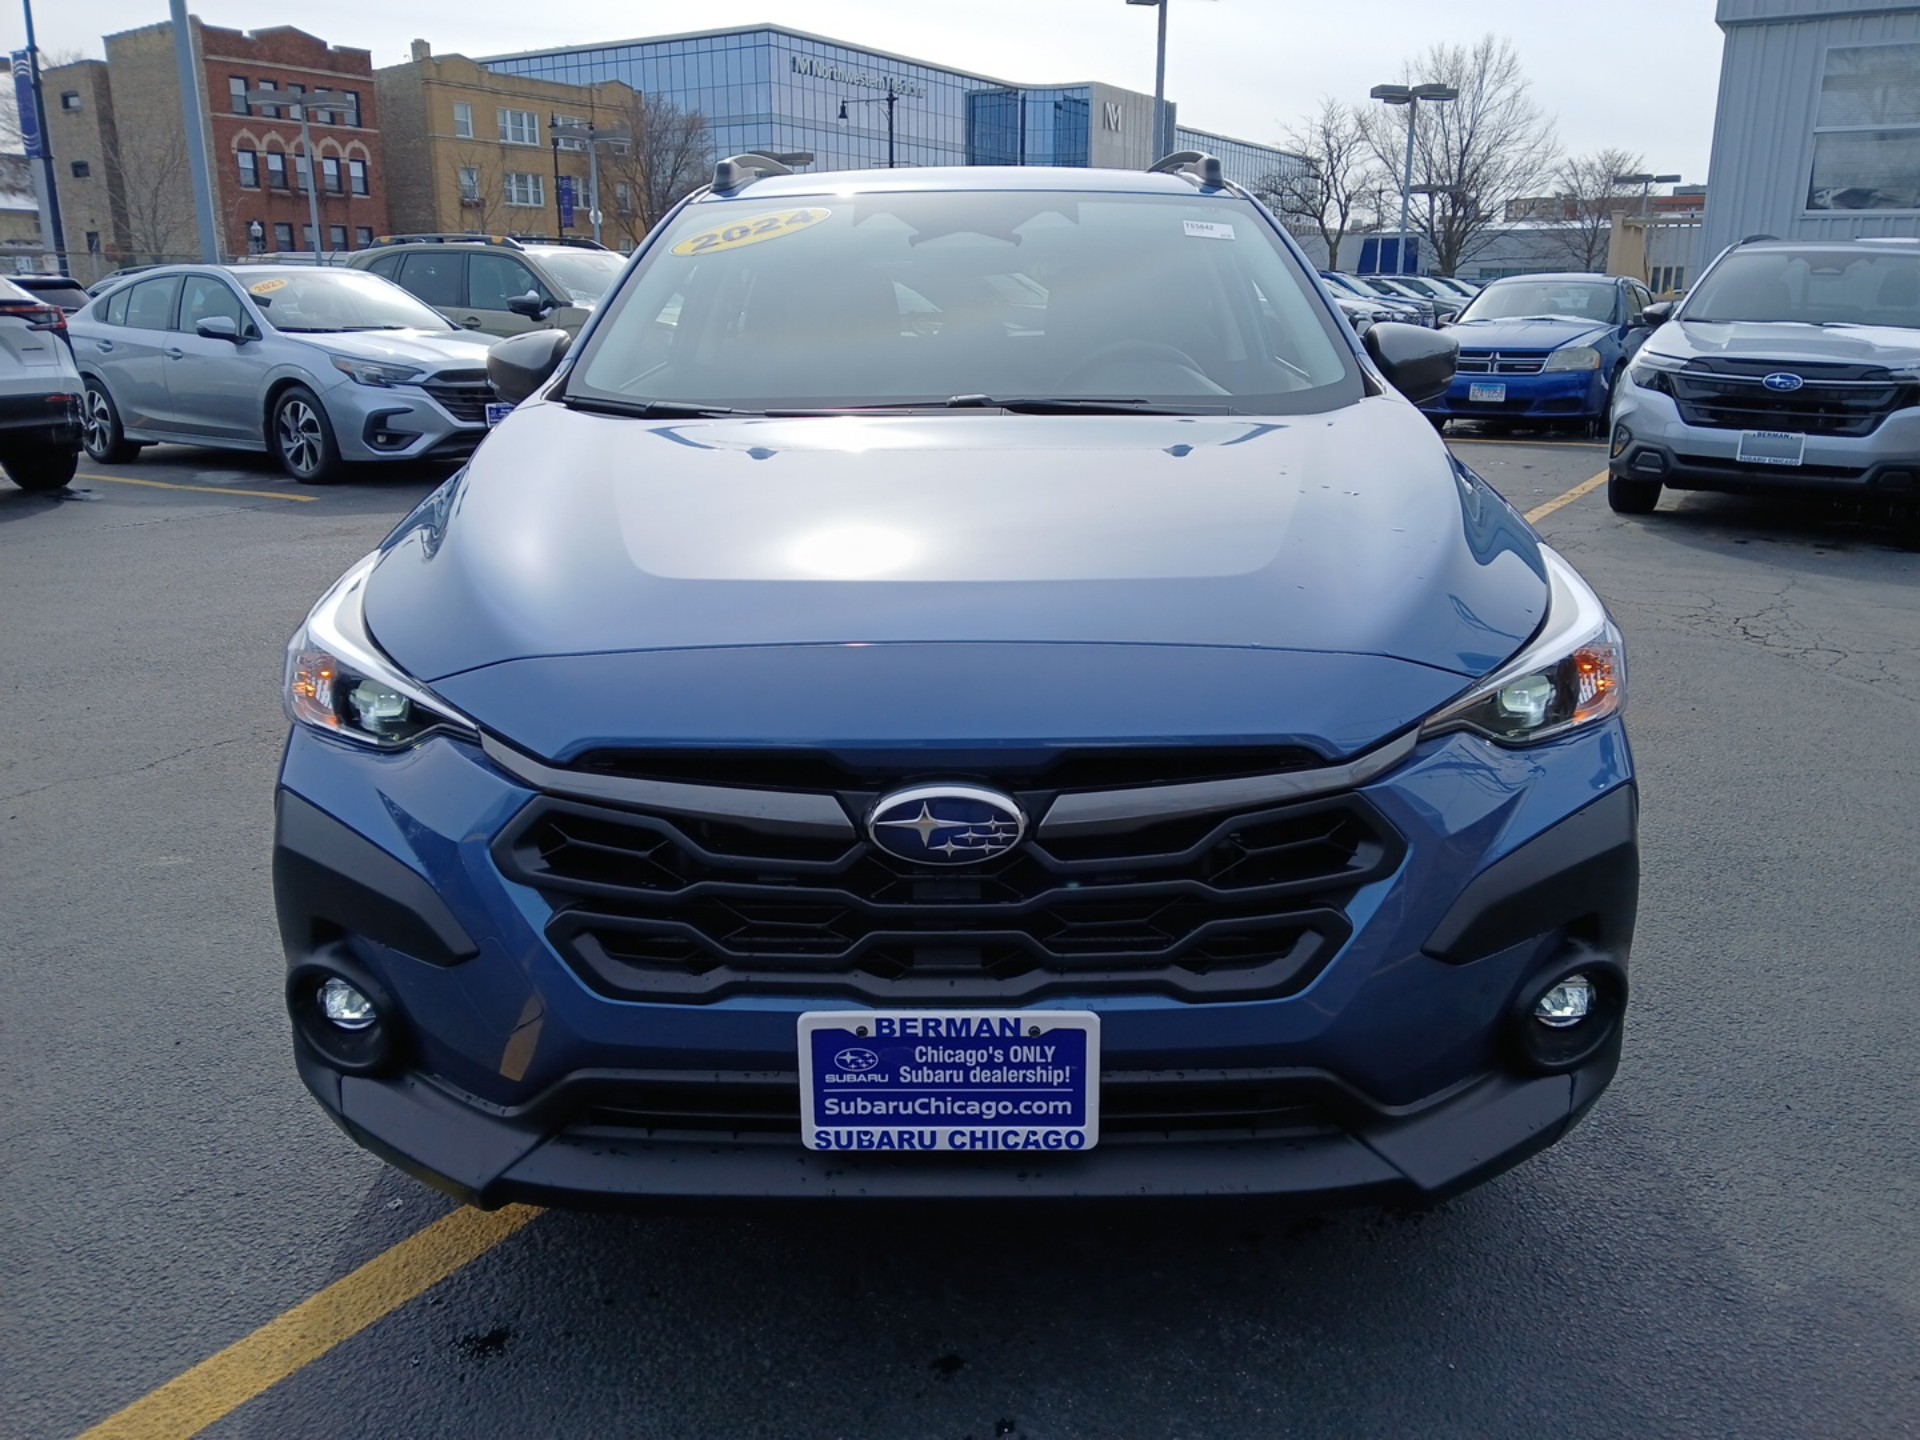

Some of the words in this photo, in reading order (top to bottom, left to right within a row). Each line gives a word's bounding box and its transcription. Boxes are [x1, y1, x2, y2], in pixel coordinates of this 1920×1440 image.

[813, 60, 886, 91] Northwestern
[690, 210, 814, 253] 2024
[1756, 431, 1790, 440] BERMAN
[875, 1017, 1021, 1037] BERMAN
[915, 1046, 1004, 1066] Chicago's
[1010, 1046, 1056, 1062] ONLY
[825, 1073, 889, 1083] SUBARU
[899, 1067, 964, 1083] Subaru
[969, 1066, 1071, 1086] dealership!
[824, 1098, 1073, 1119] SubaruChicago.com
[814, 1130, 937, 1150] SUBARU
[948, 1130, 1085, 1150] CHICAGO
